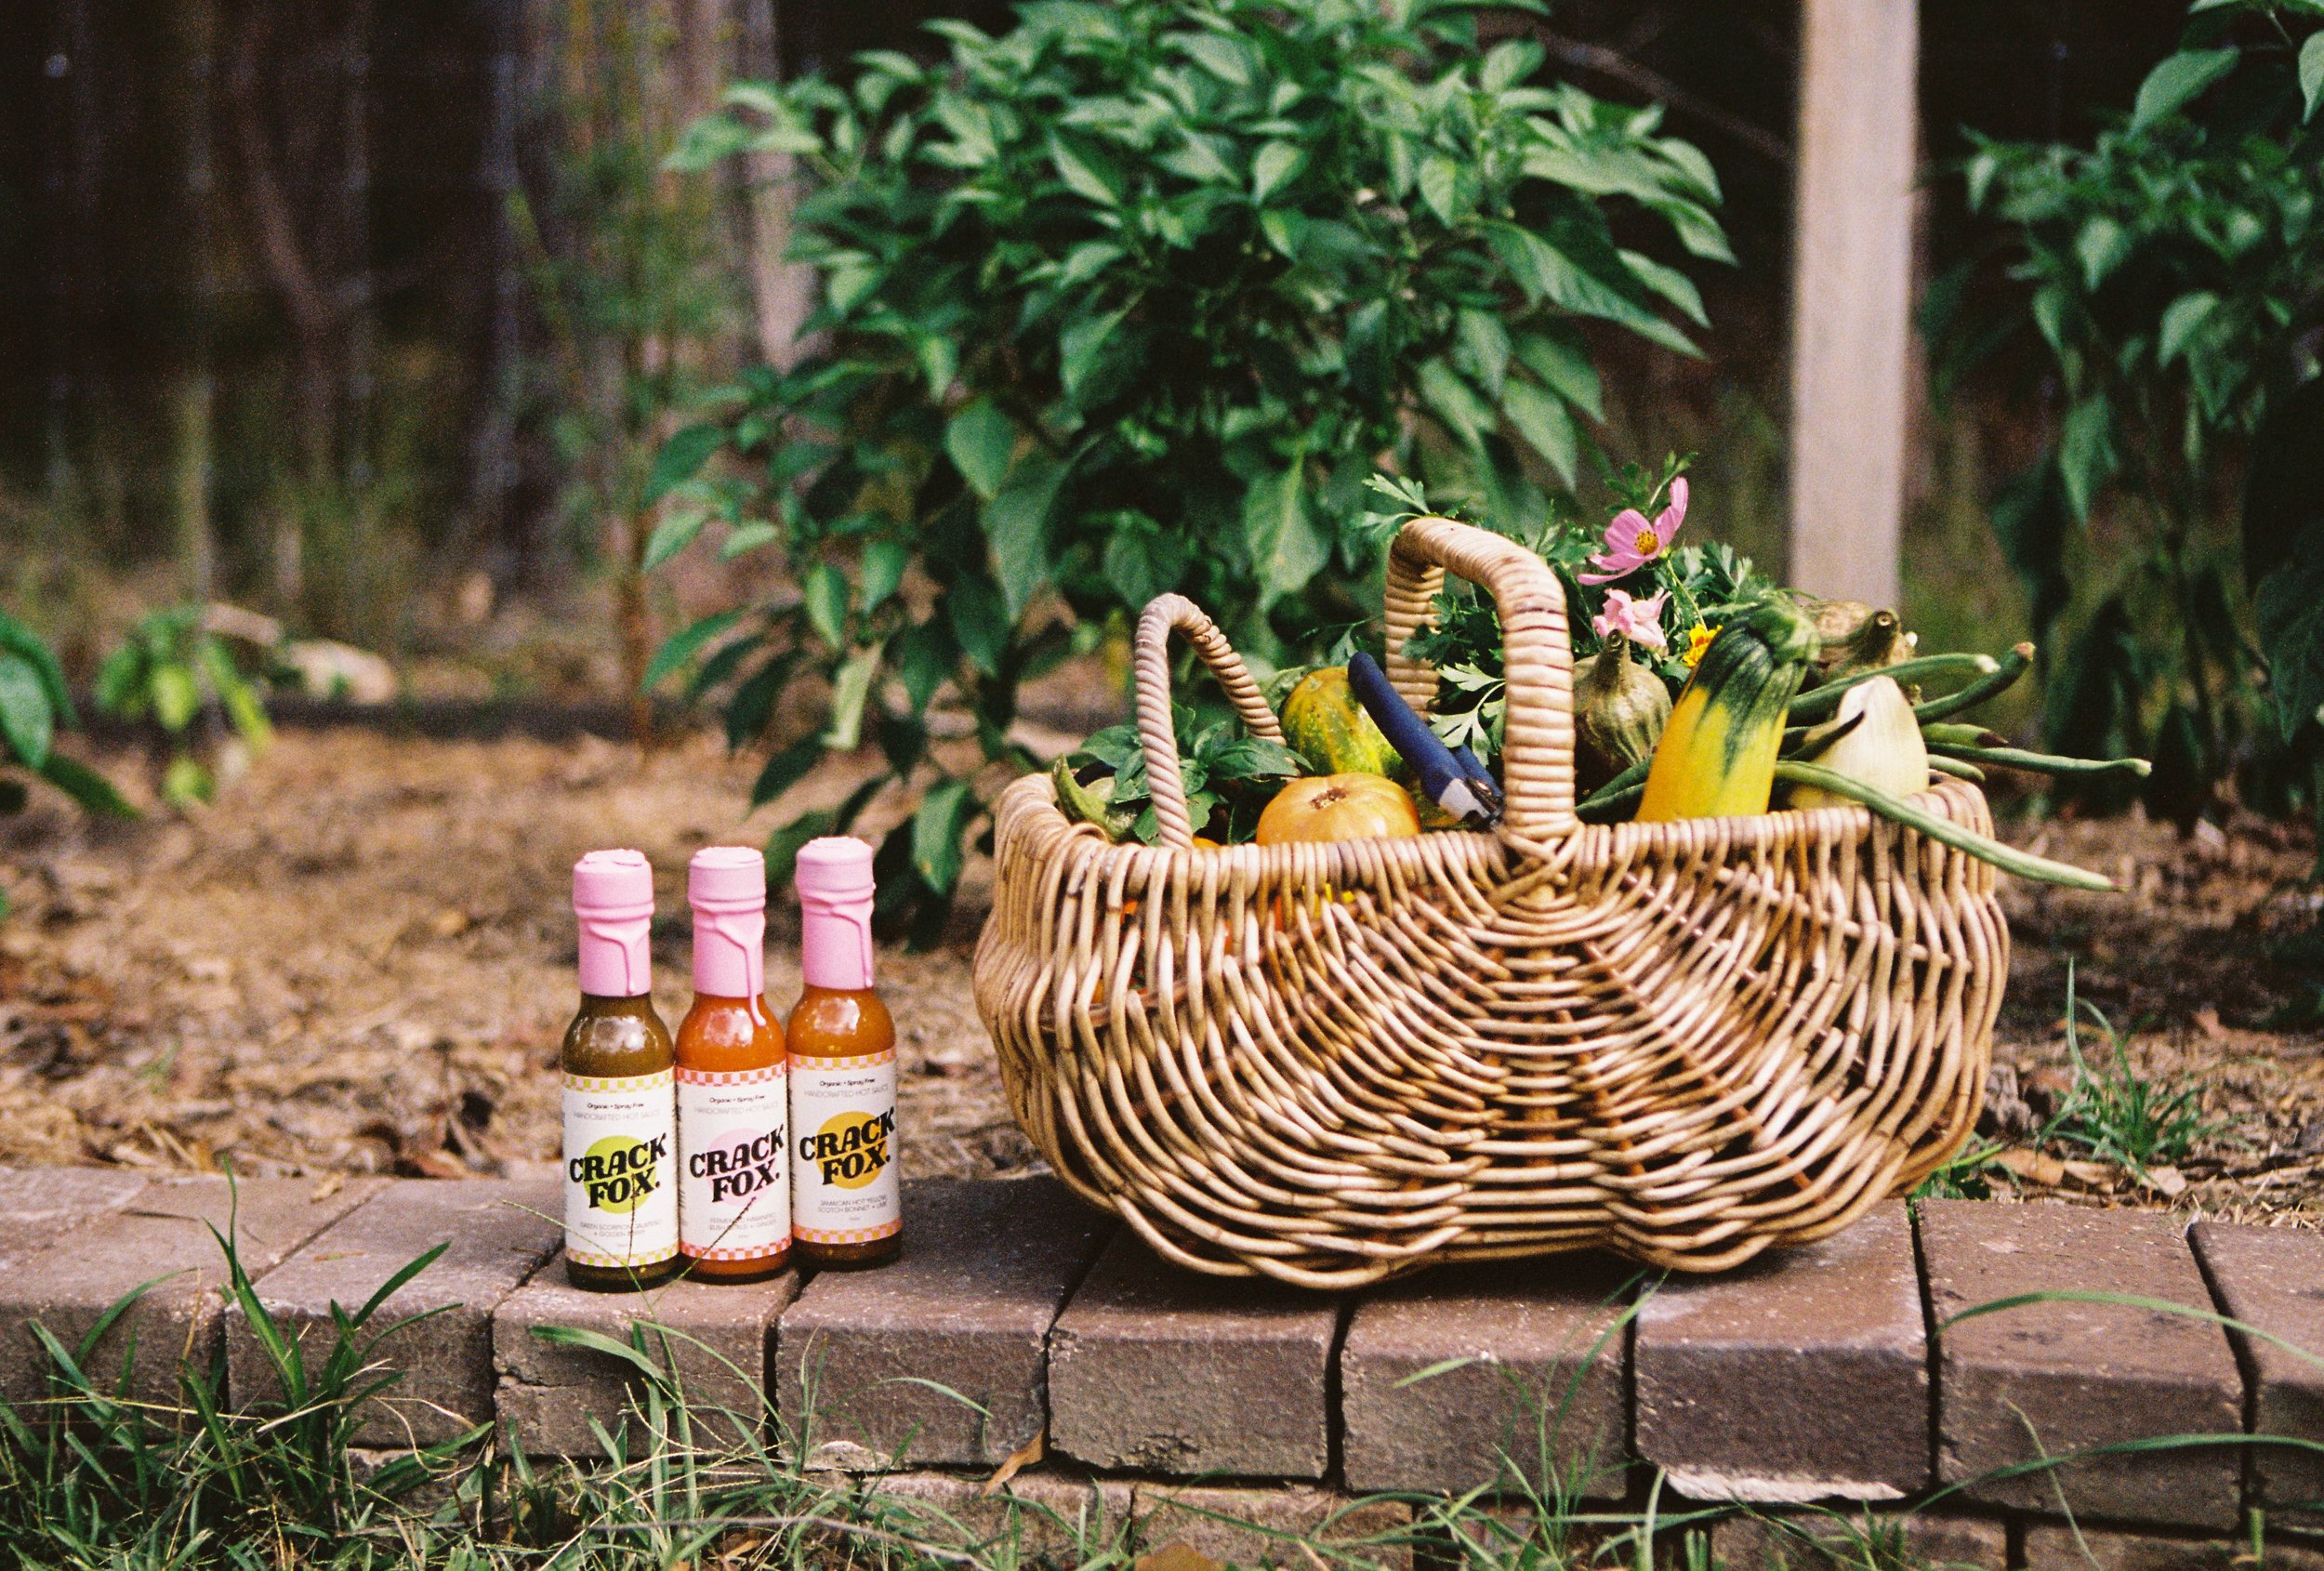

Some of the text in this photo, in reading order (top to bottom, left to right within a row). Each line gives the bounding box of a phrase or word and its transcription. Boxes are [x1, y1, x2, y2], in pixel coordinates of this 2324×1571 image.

[819, 1080, 841, 1089] Organic
[689, 1124, 784, 1178] CRACK
[799, 1106, 895, 1161] CRACK
[569, 1132, 667, 1183] CRACK
[712, 1157, 780, 1203] FOX.
[823, 1140, 891, 1185] FOX.
[589, 1166, 660, 1208] FOX.
